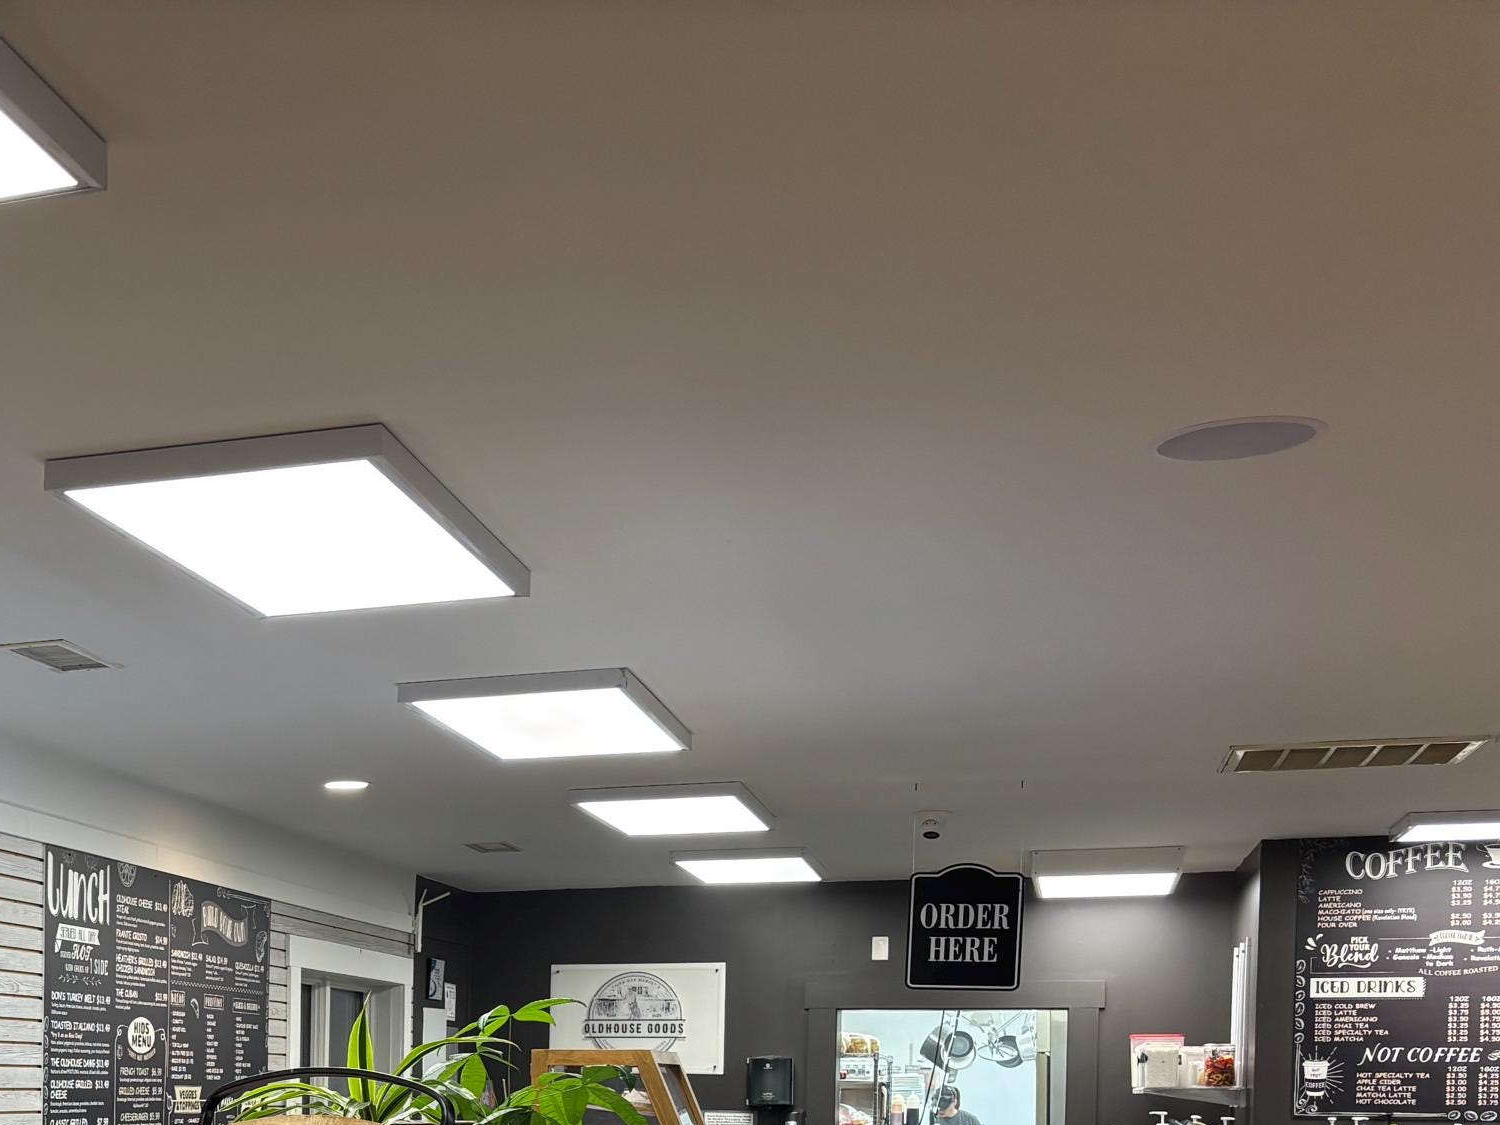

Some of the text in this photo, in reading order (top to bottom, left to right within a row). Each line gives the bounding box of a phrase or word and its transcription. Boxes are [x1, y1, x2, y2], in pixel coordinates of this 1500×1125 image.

[1345, 842, 1469, 880] COFFEE
[920, 903, 1010, 930] ORDER
[1350, 936, 1369, 944] PICK
[927, 936, 998, 963] HERE
[1320, 943, 1379, 969] Blend
[1463, 965, 1499, 975] ROASTED
[1315, 980, 1416, 995] ICED DRINKS
[133, 1022, 149, 1034] KIDS
[584, 1023, 684, 1034] OLDHOUSE GOODS
[131, 1034, 151, 1048] MENU
[1357, 1043, 1484, 1066] NOT COFFEE
